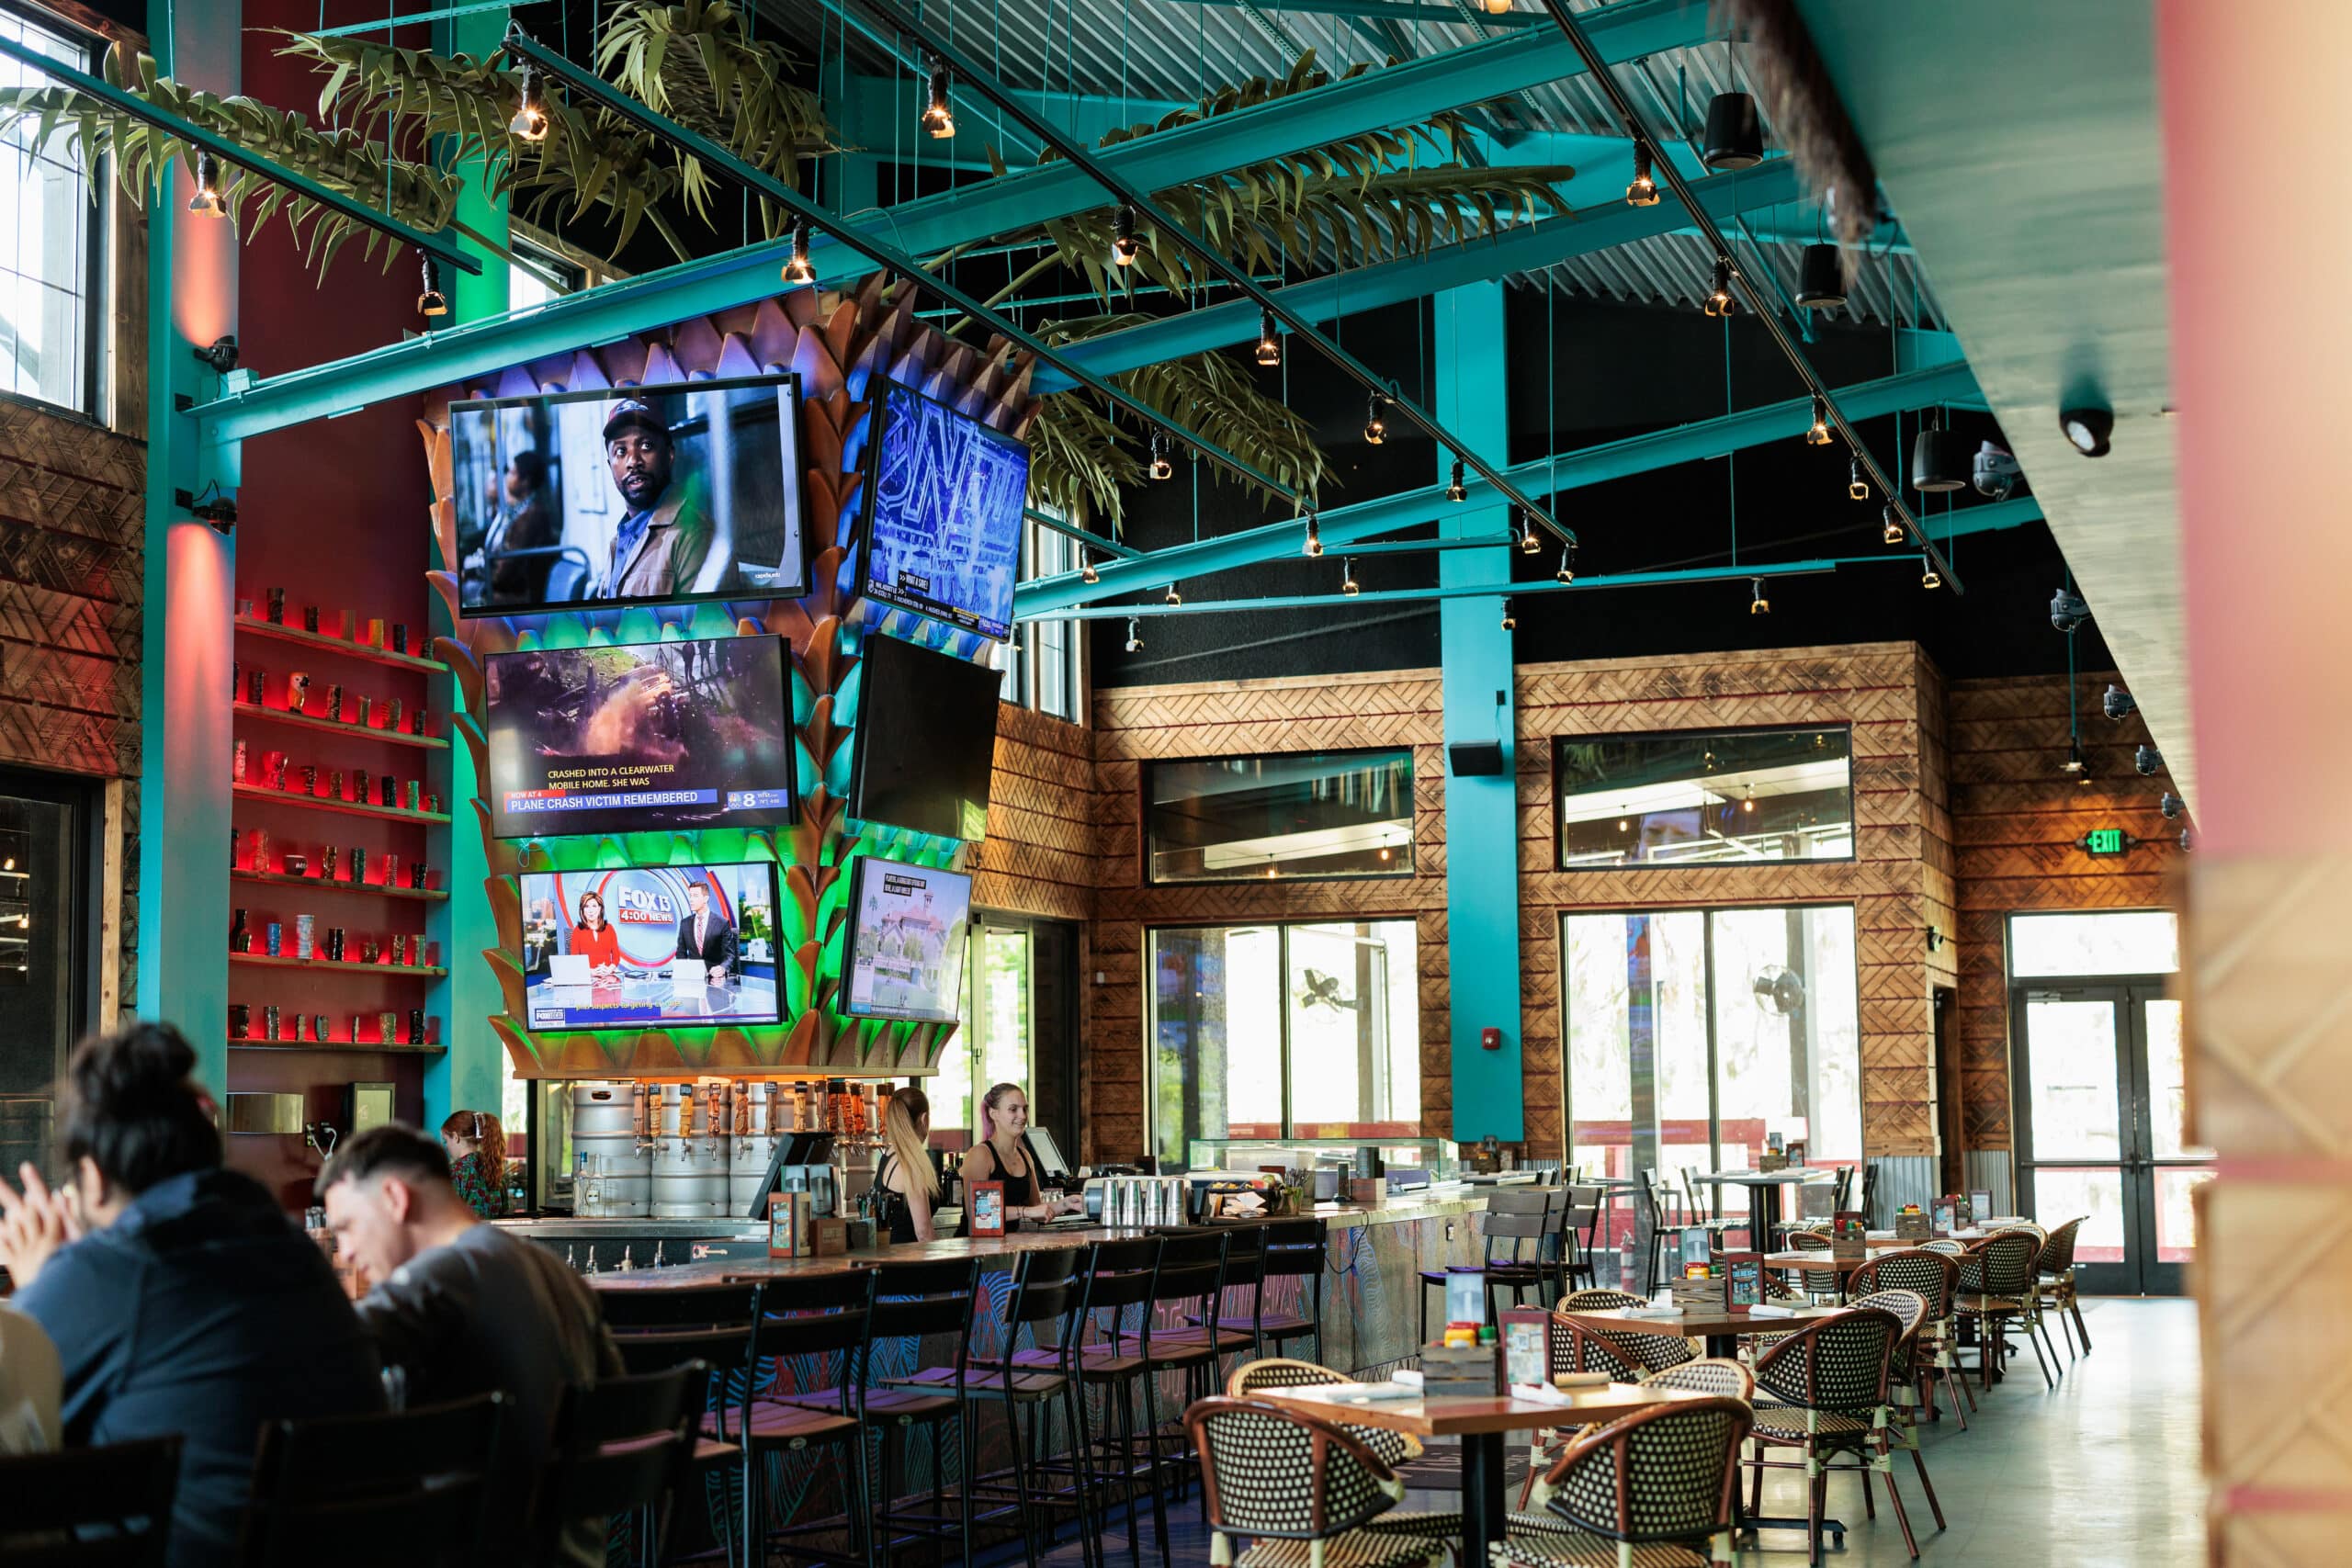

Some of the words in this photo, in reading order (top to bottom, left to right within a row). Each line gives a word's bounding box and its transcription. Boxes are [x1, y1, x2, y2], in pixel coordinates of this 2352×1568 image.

[548, 769, 585, 779] CRASHED
[588, 768, 608, 777] INTO
[610, 767, 617, 776] A
[618, 764, 674, 775] CLEARWATER
[548, 781, 580, 790] MOBILE
[582, 780, 610, 789] HOME.
[612, 778, 628, 787] SHE
[629, 777, 650, 786] WAS
[511, 799, 545, 810] PLANE
[548, 797, 583, 808] CRASH
[586, 795, 621, 807] VICTIM
[624, 792, 698, 805] REMEMBERED
[743, 793, 756, 807] 8
[2092, 829, 2120, 852] EXIT
[618, 886, 659, 911] FOX
[659, 896, 672, 911] 13
[621, 910, 647, 920] 4:00
[650, 912, 673, 921] NEWS
